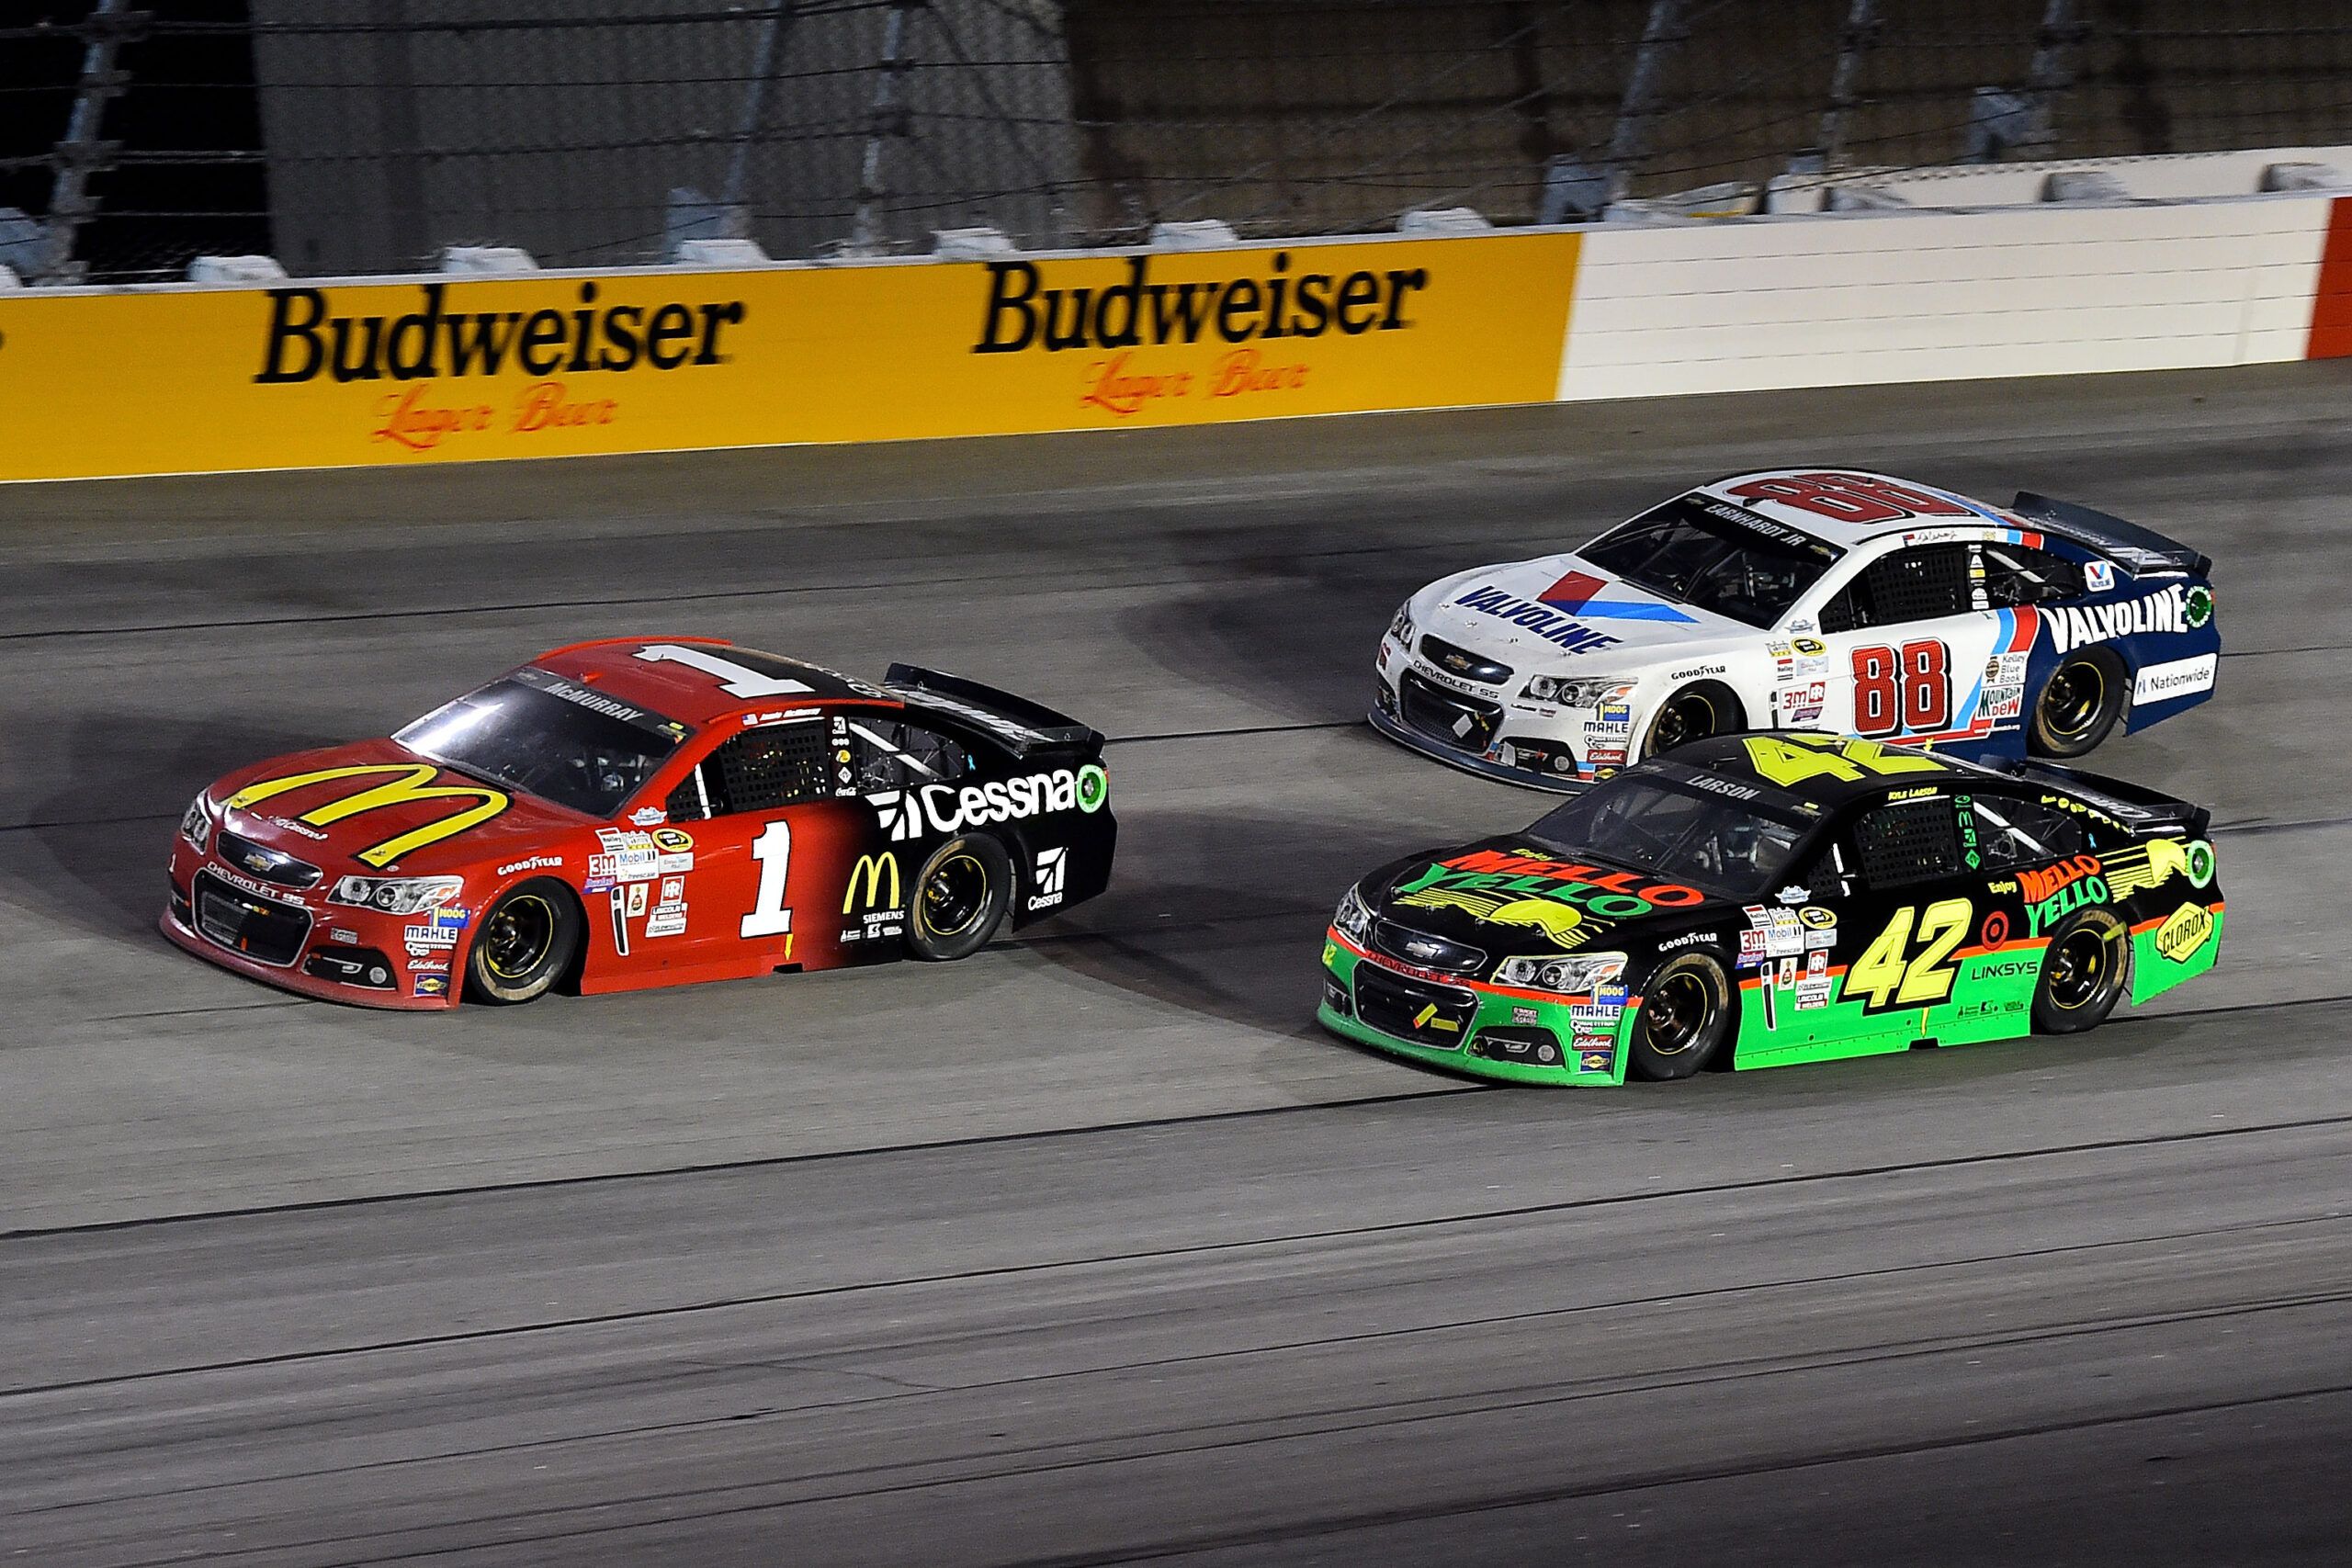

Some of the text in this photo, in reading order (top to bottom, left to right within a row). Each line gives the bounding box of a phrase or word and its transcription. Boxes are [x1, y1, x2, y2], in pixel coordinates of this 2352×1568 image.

[969, 252, 1430, 355] Budweiser
[254, 281, 746, 384] Budweiser
[1080, 348, 1311, 416] Lager Beer
[370, 382, 619, 453] Lager Beer
[1704, 503, 1806, 547] EARNHARDT JR
[1453, 585, 1623, 655] VALVOLINE
[2039, 583, 2188, 654] VALVOLINE
[633, 645, 816, 698] 1
[1413, 660, 1500, 699] CHEVROLET SS
[1671, 665, 1726, 680] GOODYEAR
[1850, 637, 1951, 736] 88
[2150, 667, 2211, 692] Nationwide
[1583, 722, 1629, 733] MAHLE
[1604, 705, 1628, 714] MOOG
[1742, 735, 1950, 787] 42
[921, 769, 1076, 832] Cessna
[1685, 774, 1762, 801] LARSON
[497, 856, 562, 875] GOODYEAR
[619, 851, 645, 863] Mobil
[207, 861, 279, 898] CHEVROLET
[740, 819, 792, 939] 1
[1398, 863, 1653, 918] YELLO
[1437, 850, 1705, 907] MELLO
[1987, 880, 2017, 895] Enjoy
[2016, 855, 2101, 904] MELLO
[863, 910, 905, 924] SIEMENS
[1028, 893, 1063, 910] Cessna
[2024, 876, 2108, 939] YELLO
[406, 927, 456, 940] MAHLE
[1658, 931, 1718, 953] GOODYEAR
[1768, 927, 1792, 938] Mobil
[2163, 910, 2207, 955] CLOROX
[1843, 897, 1973, 1008] 42
[1971, 961, 2038, 981] LINKSYS
[1600, 987, 1623, 996] MOOG
[1571, 1006, 1620, 1017] MAHLE
[1573, 1036, 1612, 1047] Edelbrock
